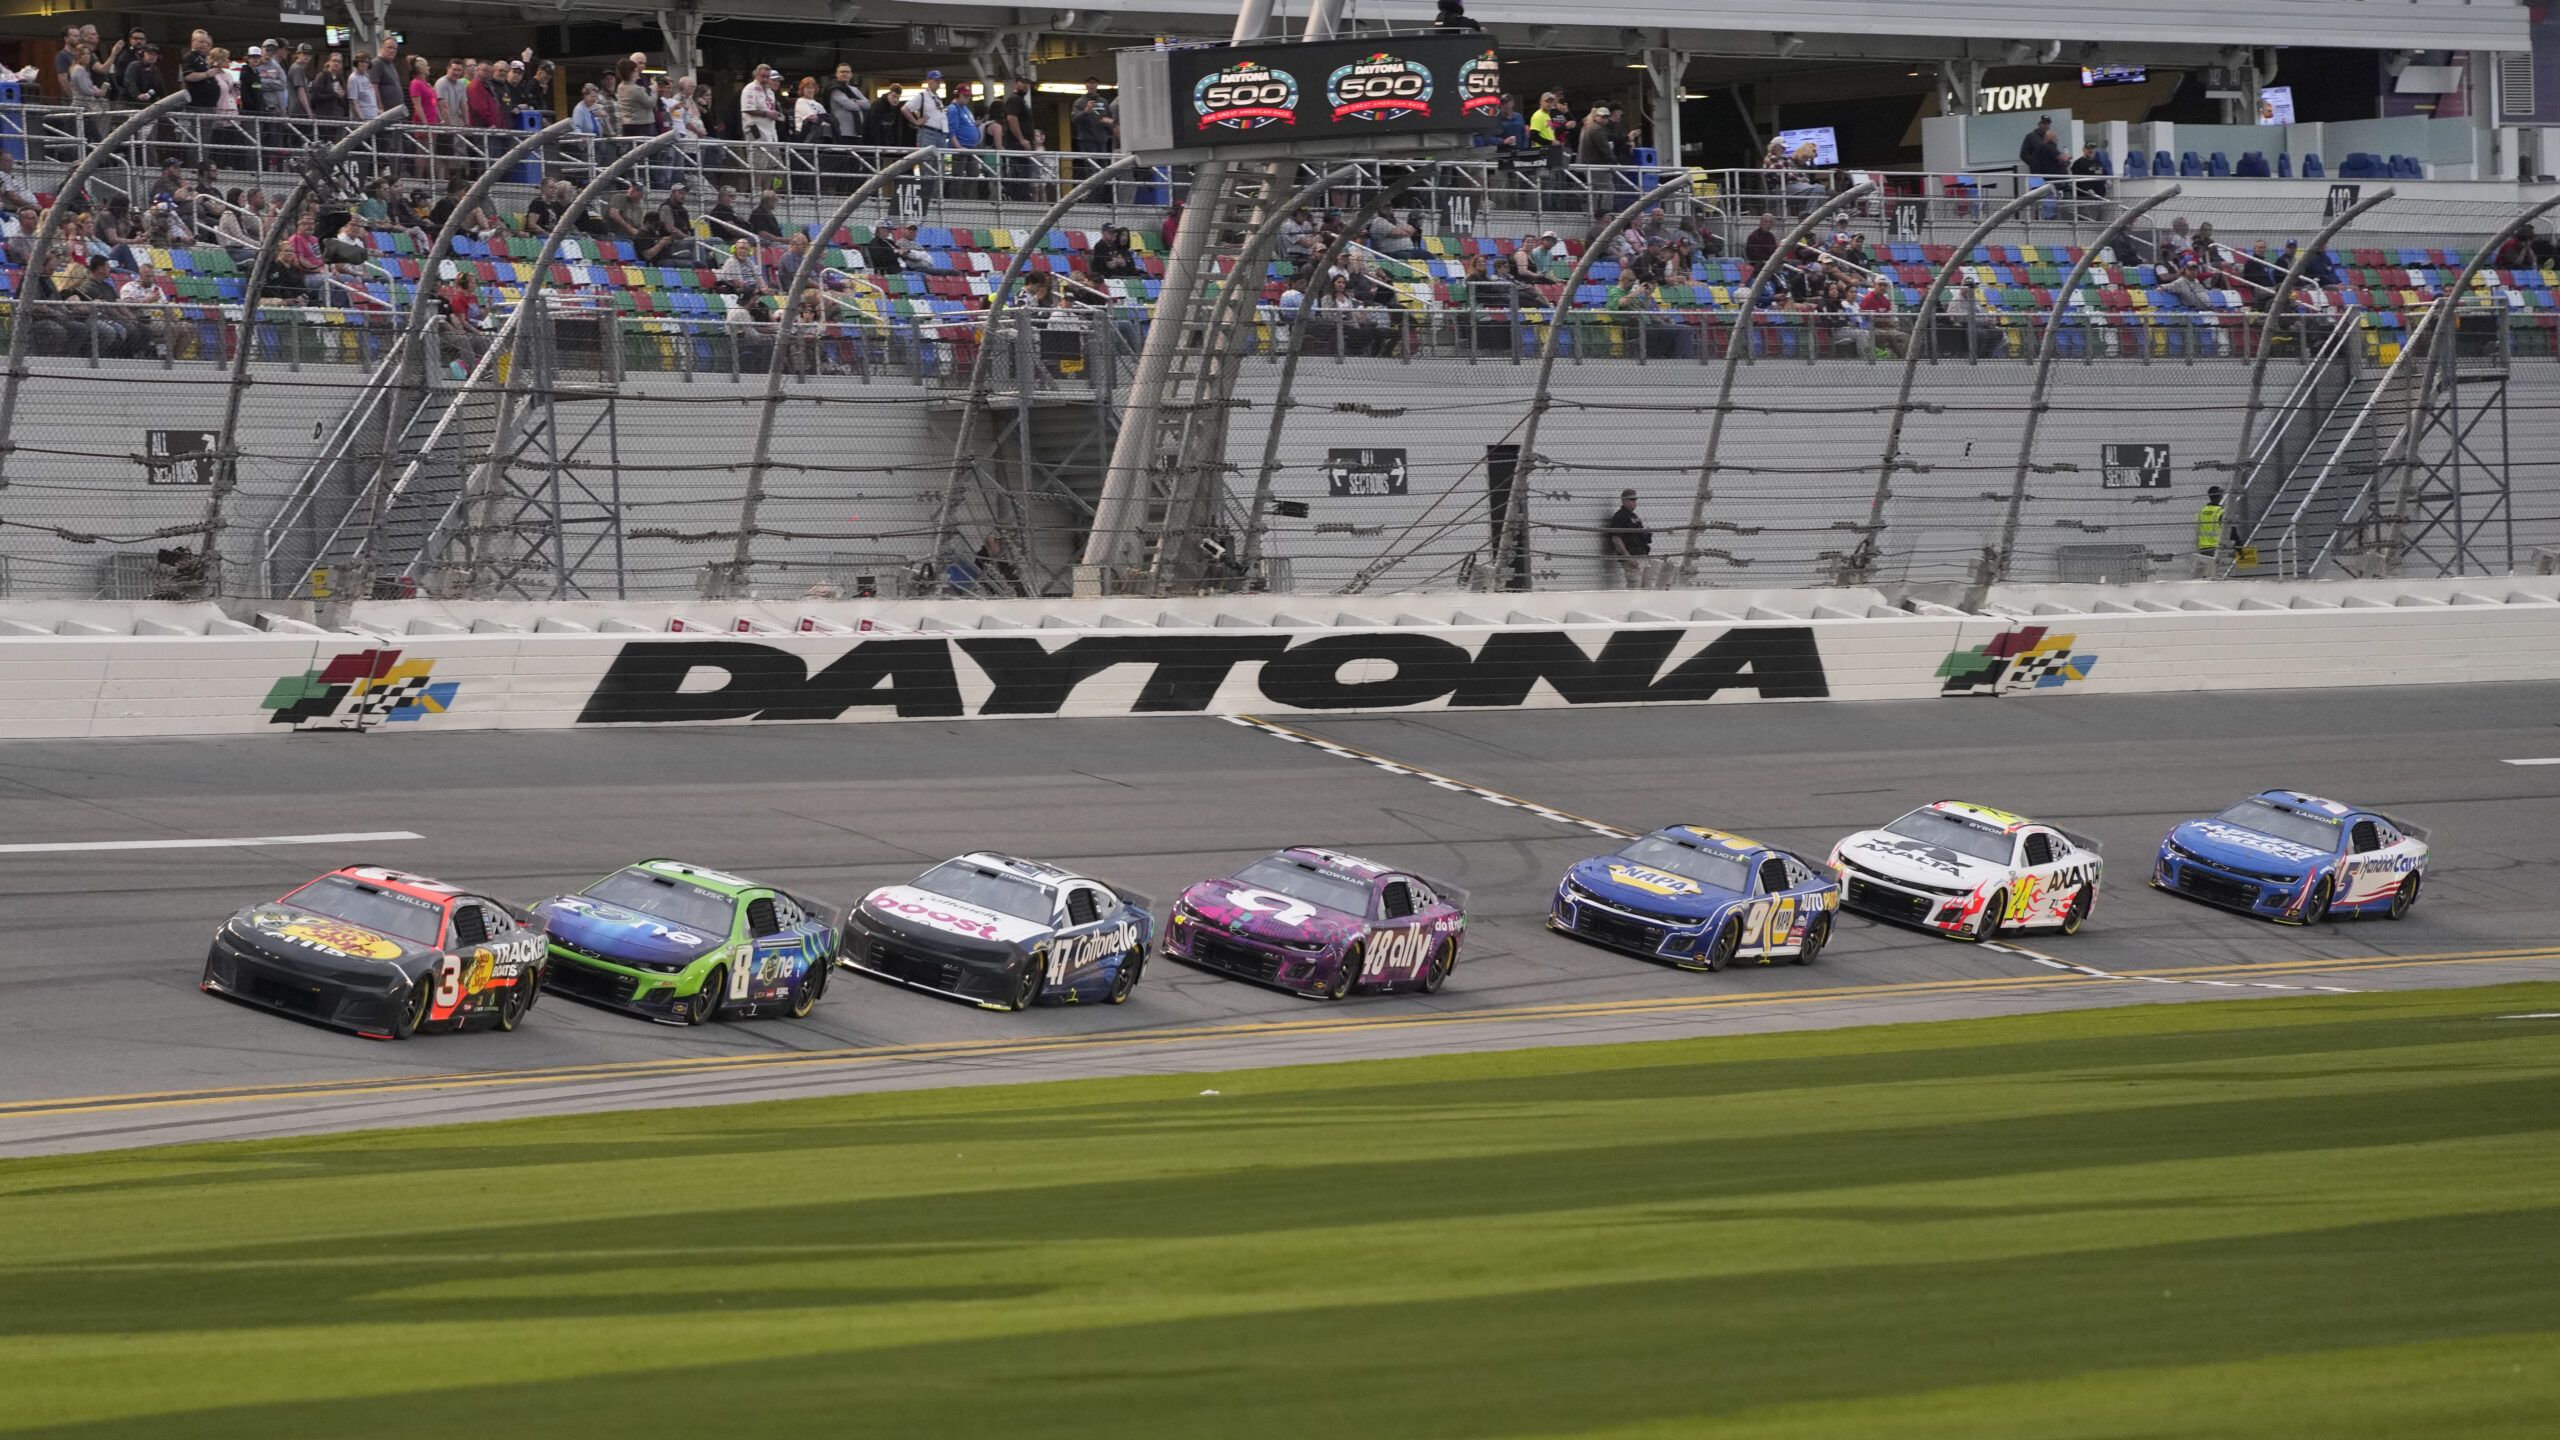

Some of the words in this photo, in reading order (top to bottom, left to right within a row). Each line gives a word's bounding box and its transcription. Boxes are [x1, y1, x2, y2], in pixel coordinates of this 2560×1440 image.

[1220, 71, 1270, 83] DAYTONA
[1354, 63, 1405, 75] DAYTONA
[1206, 83, 1288, 107] 500
[1339, 75, 1422, 99] 500
[896, 183, 923, 222] 145
[1448, 196, 1474, 234] 144
[1895, 205, 1918, 242] 143
[152, 432, 170, 456] ALL
[2105, 446, 2119, 466] ALL
[153, 459, 199, 483] SECTIONS
[2105, 466, 2142, 487] SECTIONS
[1348, 472, 1390, 495] SECTIONS
[576, 627, 1830, 723] DAYTONA
[1968, 821, 2002, 836] BYRON
[2295, 810, 2333, 825] LARSON
[1854, 842, 1960, 877] AXALTA
[1318, 868, 1365, 887] BOWMAN
[1620, 866, 1689, 891] NAPA
[2332, 862, 2362, 903] 5
[1800, 893, 1824, 911] AUTO
[2003, 876, 2037, 920] 24
[870, 892, 1000, 941] boost
[1434, 917, 1447, 931] do
[1740, 901, 1770, 946] 9
[1074, 920, 1137, 969] Cottonelle
[1362, 929, 1394, 976] 48
[1389, 921, 1432, 981] ally
[492, 964, 518, 977] BOATS
[729, 944, 753, 1000] 8
[1046, 939, 1073, 986] 47
[436, 954, 462, 1008] 3
